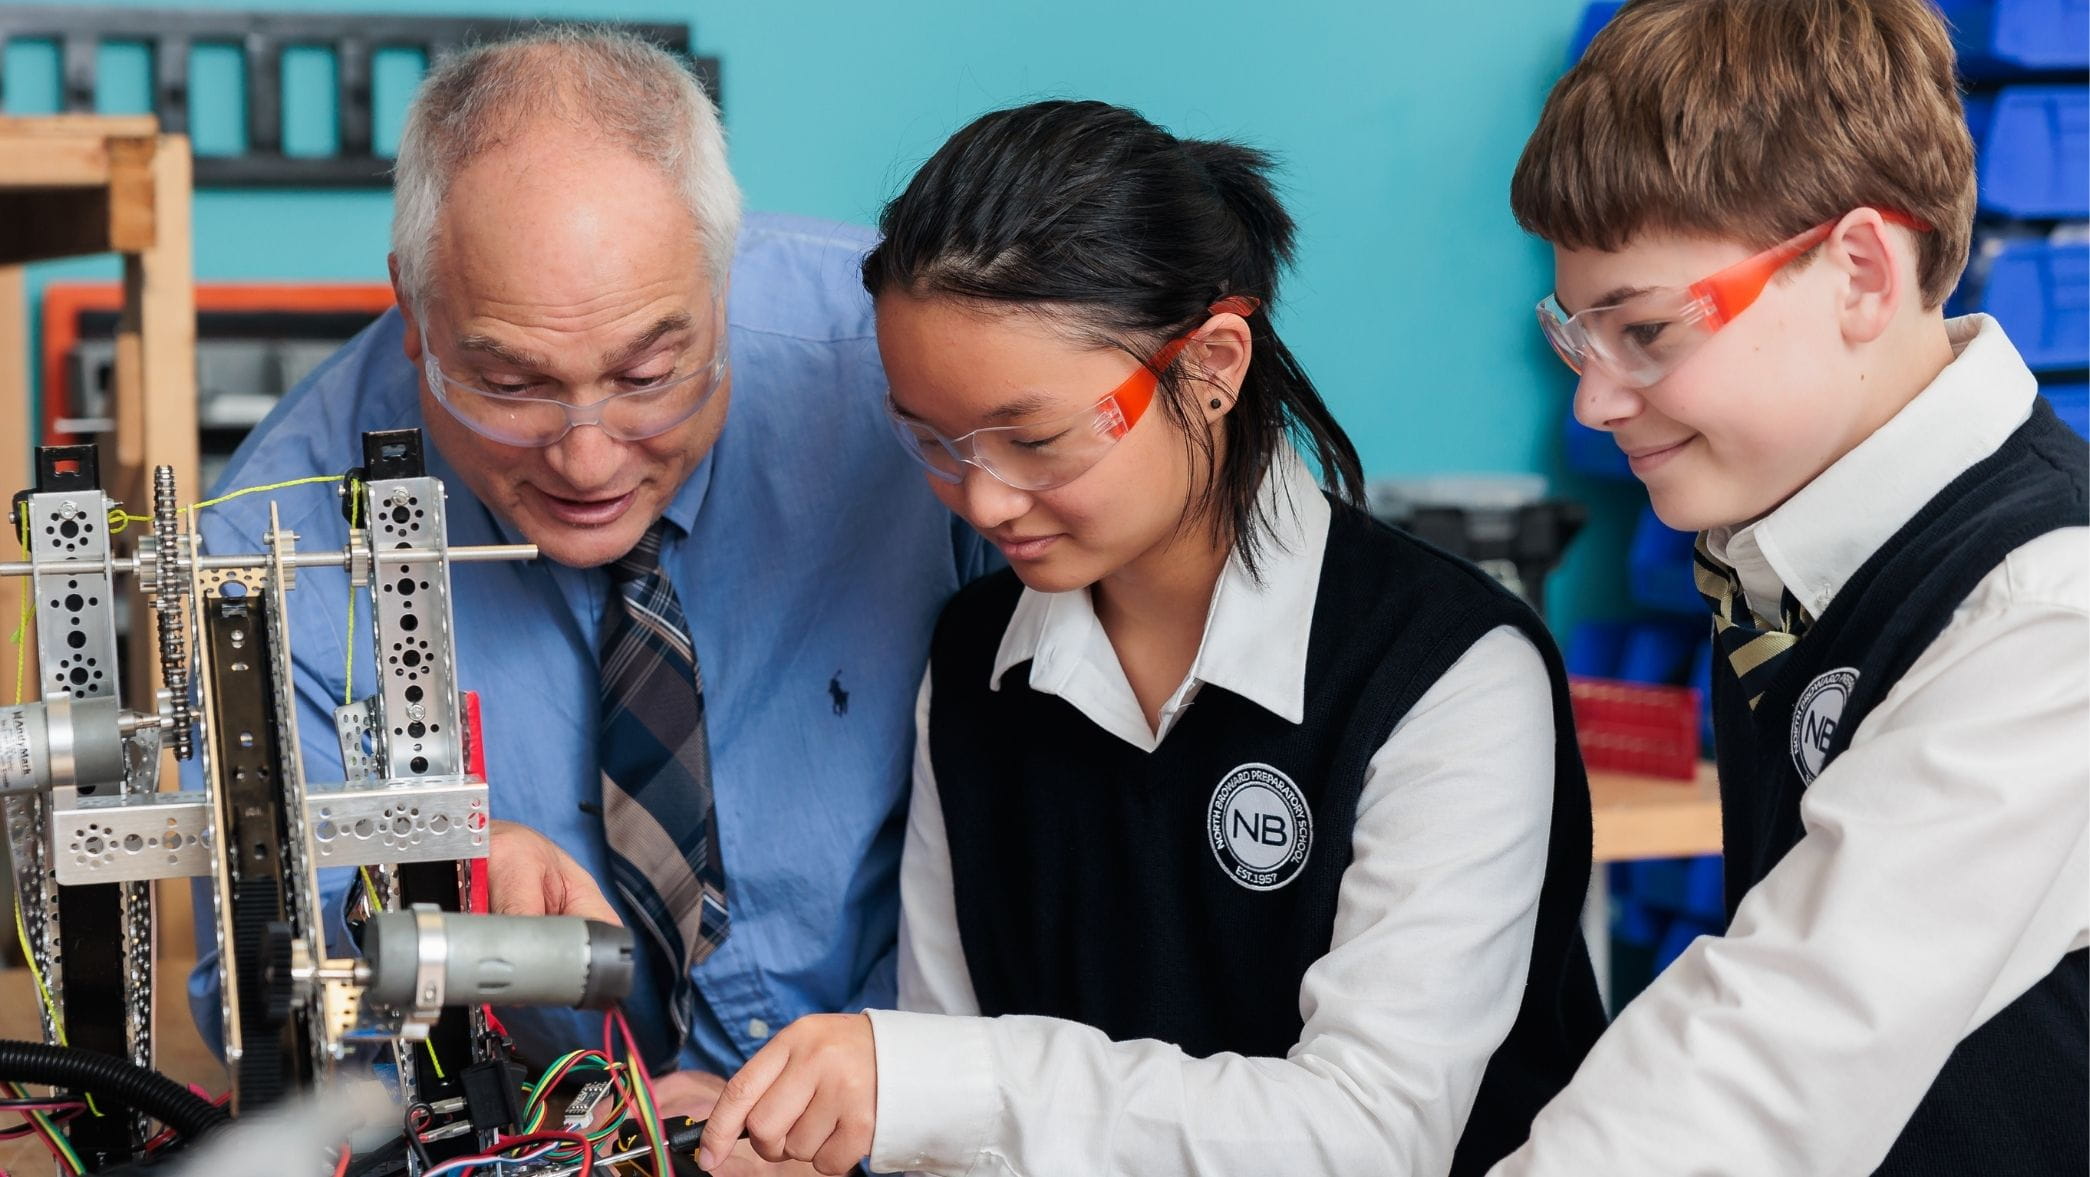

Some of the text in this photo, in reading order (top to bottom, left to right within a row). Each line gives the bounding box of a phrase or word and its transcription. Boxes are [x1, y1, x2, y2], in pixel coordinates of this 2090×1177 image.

[1805, 710, 1837, 754] NB
[1212, 770, 1308, 864] NORTH BROWARD PREPARATORY SCHOOL
[1233, 808, 1288, 847] NB
